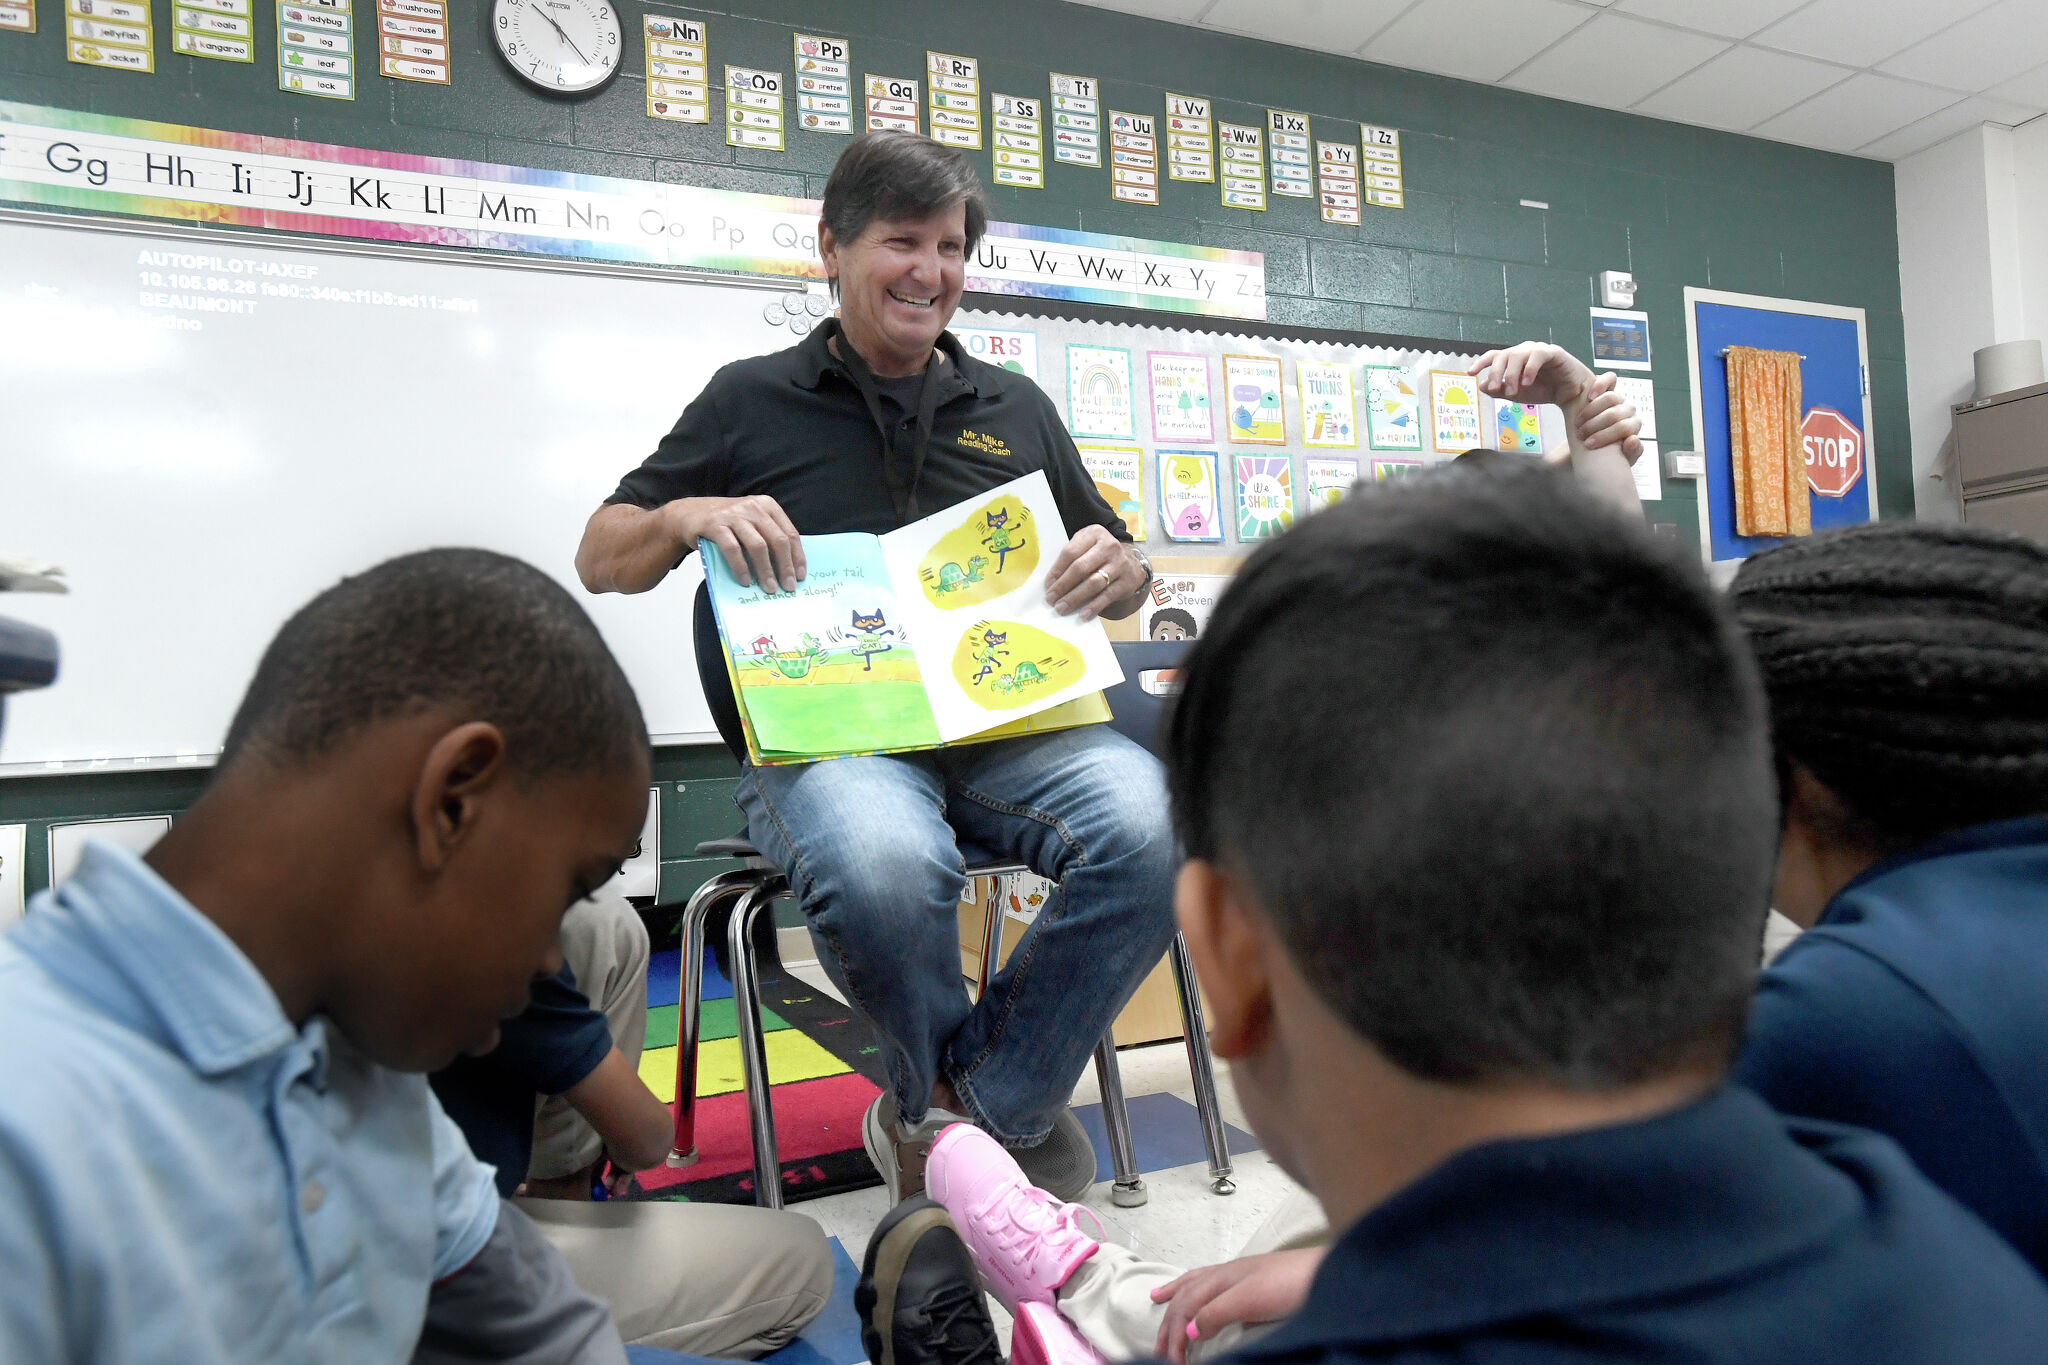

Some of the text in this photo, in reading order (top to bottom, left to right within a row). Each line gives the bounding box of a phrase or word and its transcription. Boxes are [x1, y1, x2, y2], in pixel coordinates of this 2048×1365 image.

[110, 6, 130, 16] jam
[216, 0, 234, 9] key
[397, 4, 442, 16] mushroom
[600, 7, 608, 20] 2
[210, 20, 236, 30] koala
[307, 14, 342, 28] ladybug
[500, 16, 508, 29] 9
[100, 26, 140, 40] jellyfish
[409, 25, 436, 35] mouse
[672, 22, 698, 40] Nn
[320, 38, 333, 48] log
[608, 32, 616, 44] 3
[200, 40, 245, 54] kangaroo
[414, 46, 432, 56] map
[508, 43, 517, 56] 8
[822, 42, 842, 60] Pp
[108, 53, 140, 64] jacket
[318, 60, 336, 68] leaf
[602, 56, 610, 68] 4
[412, 66, 436, 76] moon
[530, 63, 538, 76] 7
[952, 60, 971, 76] Rr
[318, 82, 336, 90] lock
[557, 74, 566, 86] 6
[752, 74, 778, 91] Oo
[890, 82, 912, 100] Qq
[1074, 81, 1090, 96] Tt
[822, 102, 841, 110] pencil
[1017, 102, 1034, 116] Ss
[1184, 101, 1204, 116] Vv
[1015, 122, 1033, 130] spider
[1132, 118, 1150, 134] Uu
[1286, 117, 1304, 132] Xx
[1234, 129, 1256, 144] Ww
[1379, 130, 1392, 144] Zz
[1124, 155, 1153, 165] underwear
[1336, 147, 1350, 162] Yy
[46, 142, 817, 258] Gg Hh Ii Jj Kk Ll Mm Nn Oo Pp Qq
[977, 245, 1264, 299] Uu Vv Ww Xx Yy Zz
[139, 291, 258, 314] BEAUMONT
[954, 334, 1022, 356] ORS
[1154, 363, 1166, 372] We
[1306, 369, 1342, 379] We take
[1438, 406, 1450, 414] We
[963, 429, 1004, 448] Mr. Mike
[958, 437, 1011, 456] Reading Coach
[1803, 435, 1854, 468] STOP
[1254, 482, 1270, 494] We
[1178, 492, 1191, 500] HELP
[809, 566, 864, 580] your tail
[738, 592, 759, 604] and
[1150, 578, 1196, 606] Even
[1176, 594, 1213, 606] Steven
[861, 642, 878, 650] CAT
